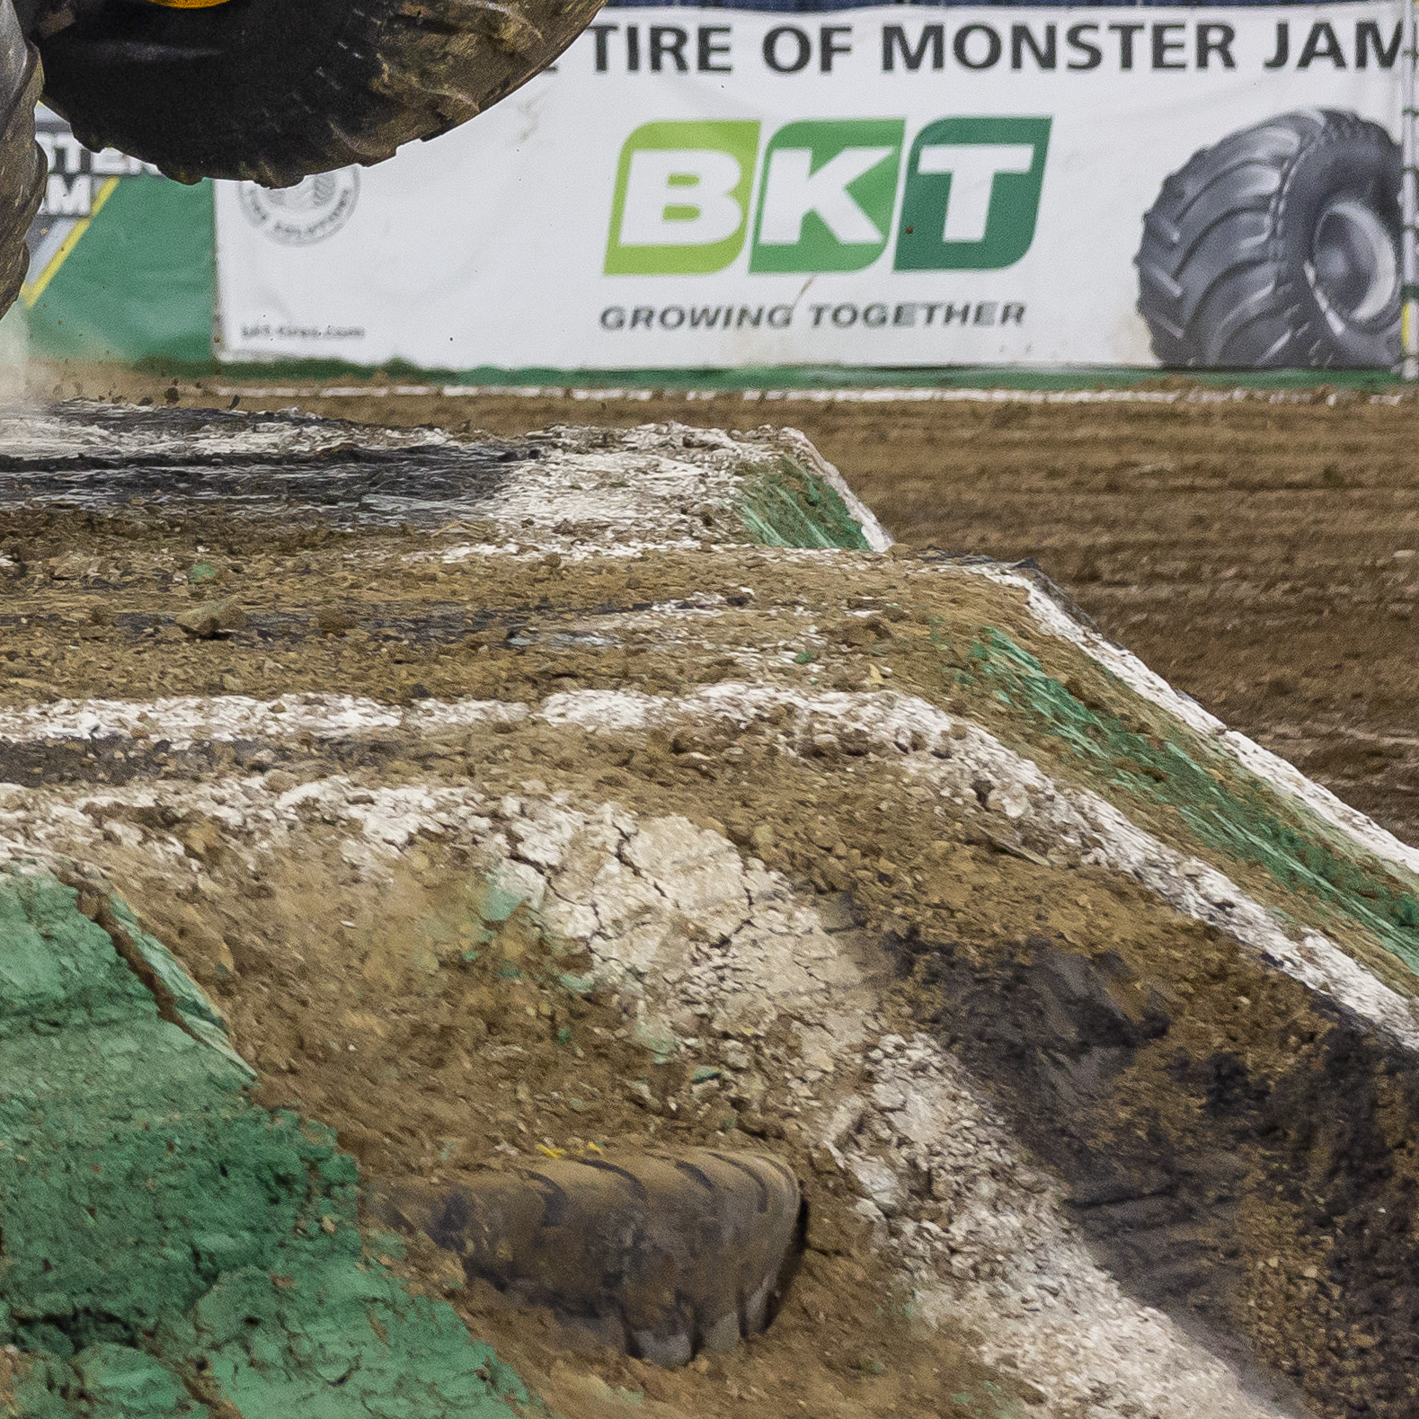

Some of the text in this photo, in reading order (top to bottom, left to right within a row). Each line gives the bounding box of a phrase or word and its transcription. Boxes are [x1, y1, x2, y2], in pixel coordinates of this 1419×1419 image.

[586, 20, 1405, 74] TIRE OF MONSTER JAM
[611, 132, 1043, 260] BKT
[599, 299, 1028, 332] GROWING TOGETHER
